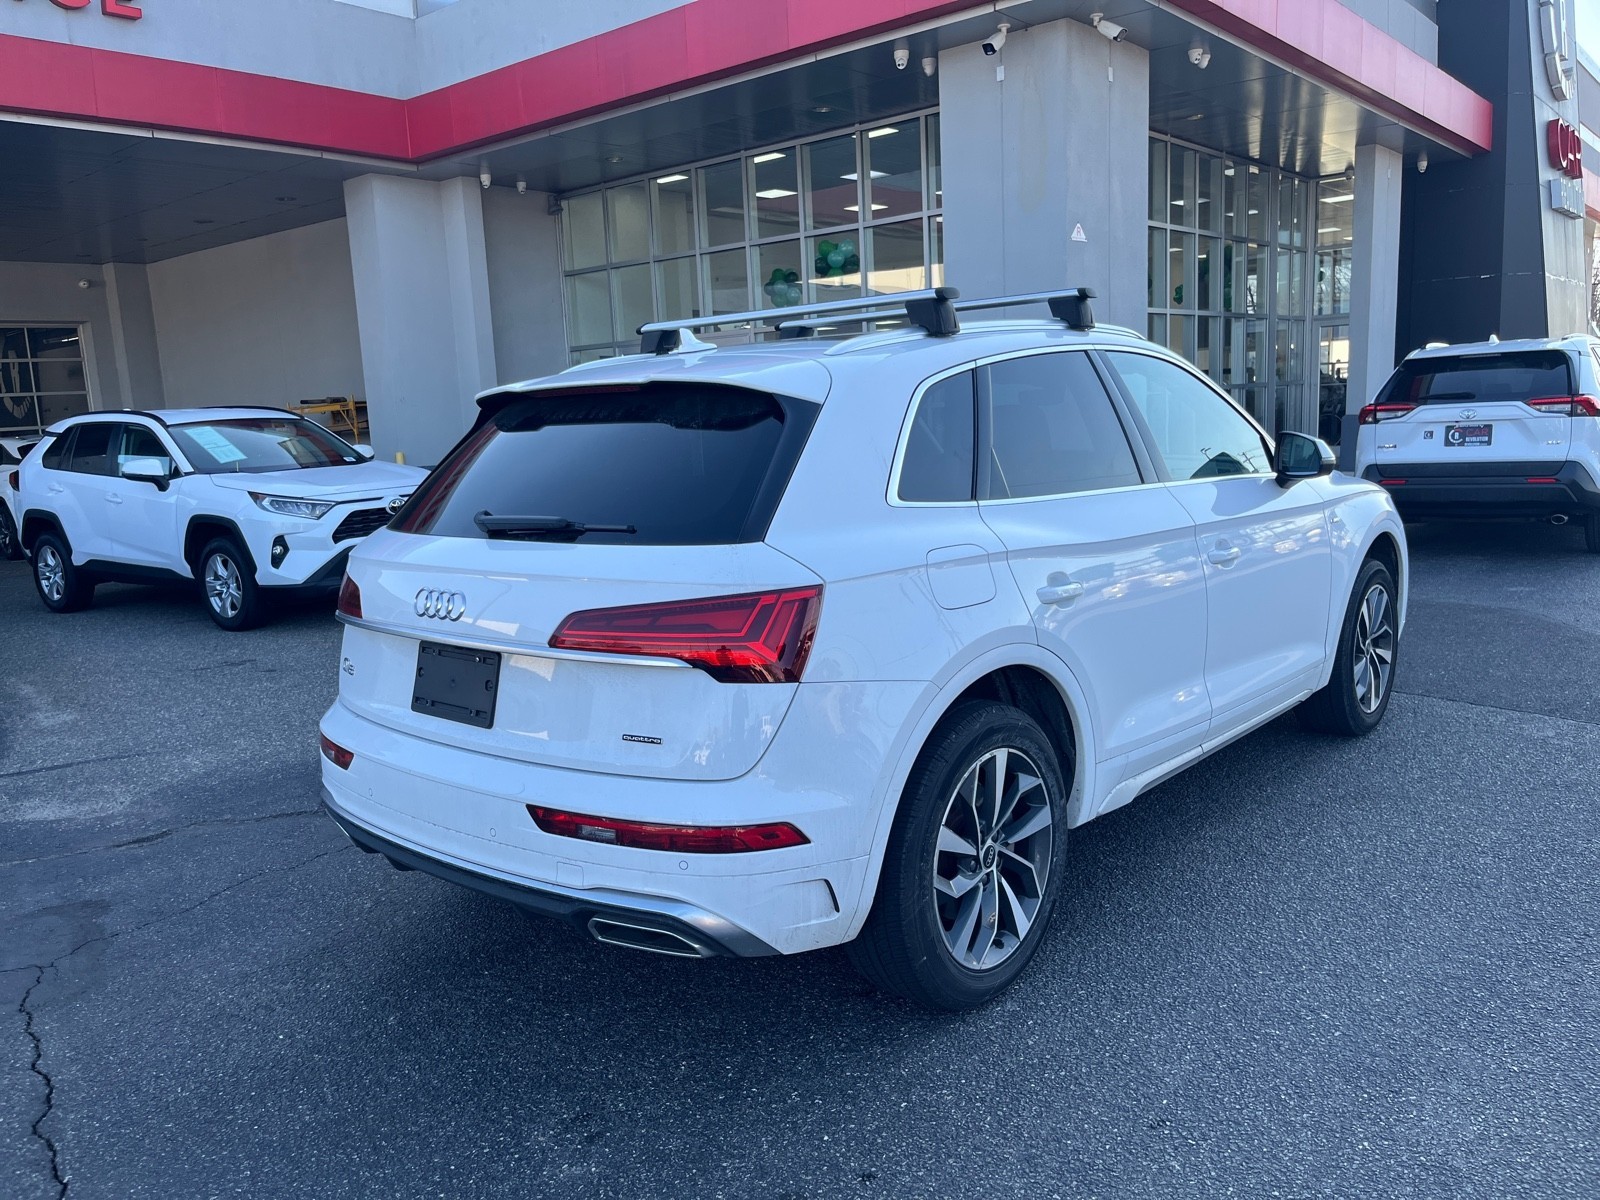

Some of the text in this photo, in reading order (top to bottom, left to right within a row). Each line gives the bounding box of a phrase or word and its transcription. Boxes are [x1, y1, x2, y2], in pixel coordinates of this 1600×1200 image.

[1548, 118, 1583, 179] CAR
[1466, 428, 1489, 436] CAR
[623, 735, 661, 744] quattro
